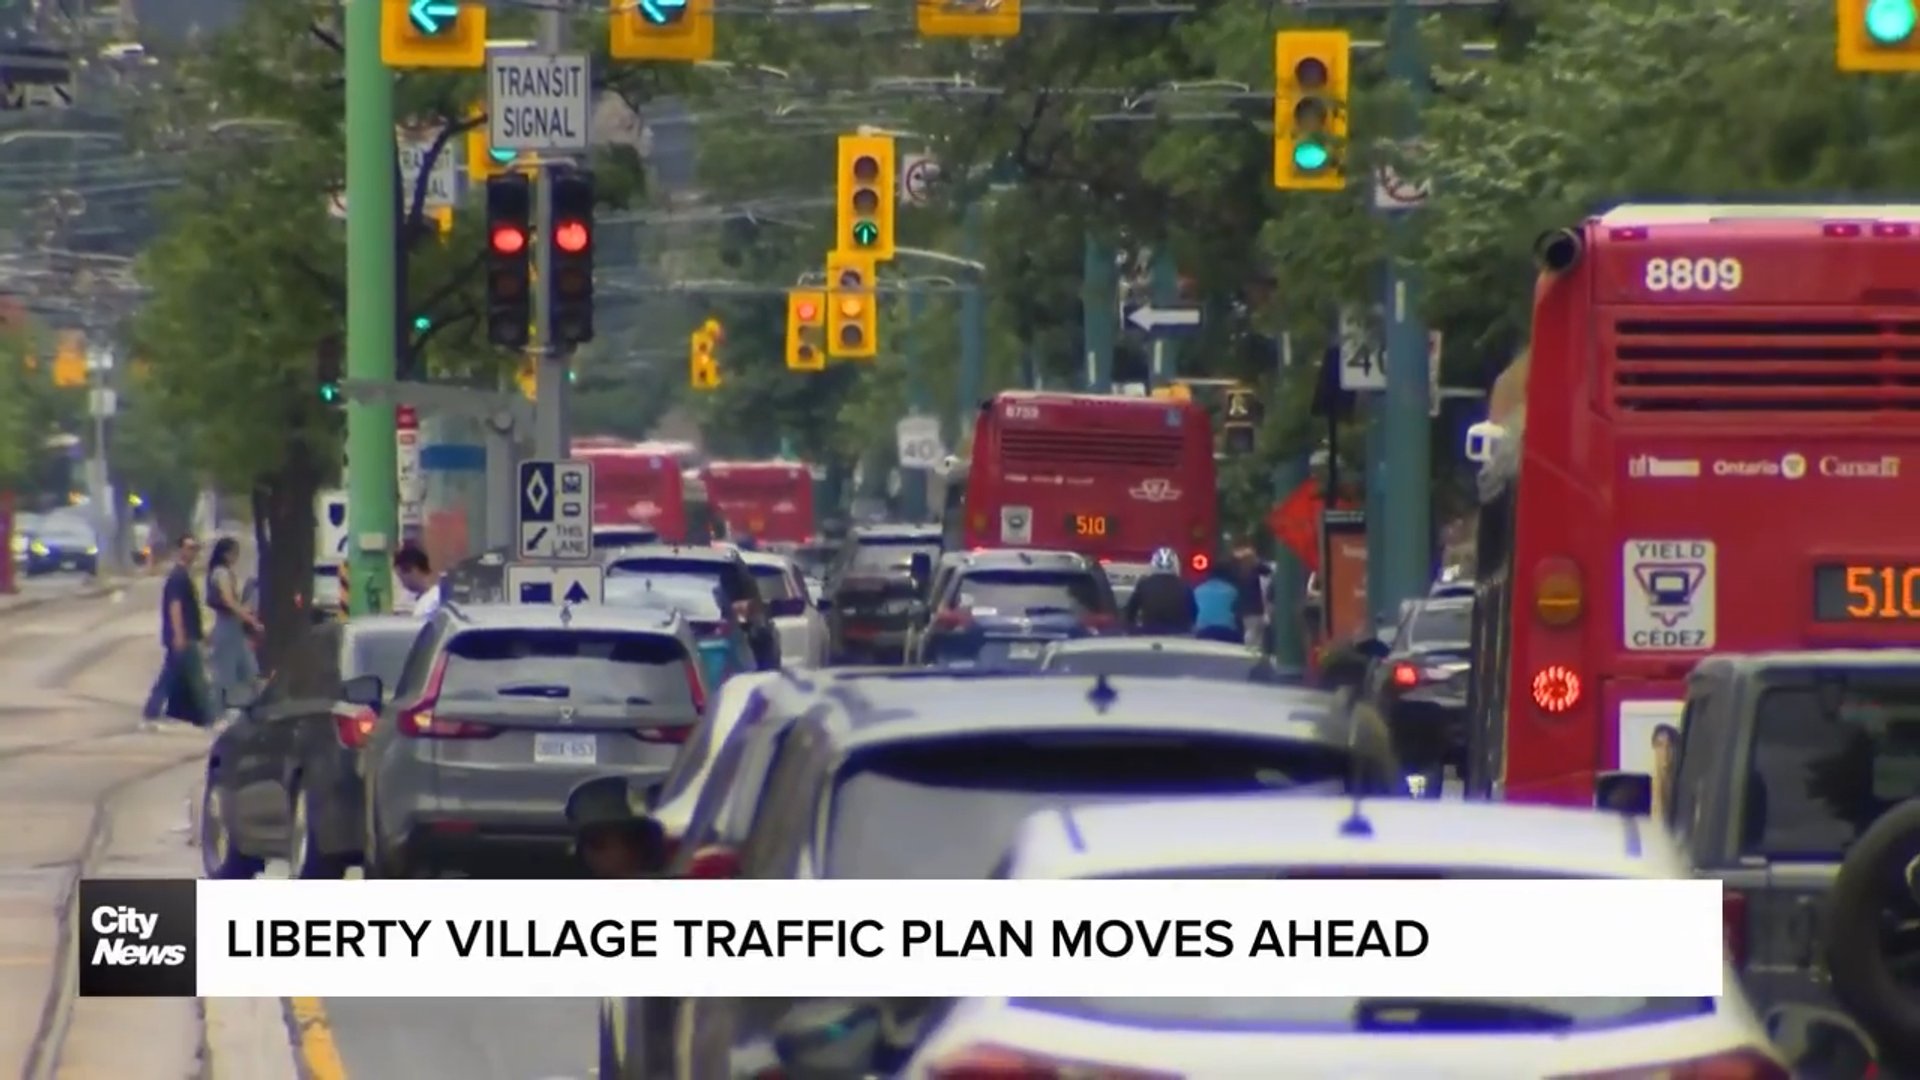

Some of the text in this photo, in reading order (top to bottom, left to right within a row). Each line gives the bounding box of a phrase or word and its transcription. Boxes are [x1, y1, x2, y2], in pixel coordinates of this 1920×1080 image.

[498, 66, 581, 97] TRANSIT
[503, 107, 576, 138] SIGNAL
[1645, 257, 1742, 291] 8809
[1713, 459, 1780, 476] Ontario
[556, 524, 583, 538] THIS
[1076, 515, 1105, 535] 510
[553, 540, 585, 554] LANE
[1636, 544, 1706, 559] YIELD
[1846, 566, 1920, 617] 510
